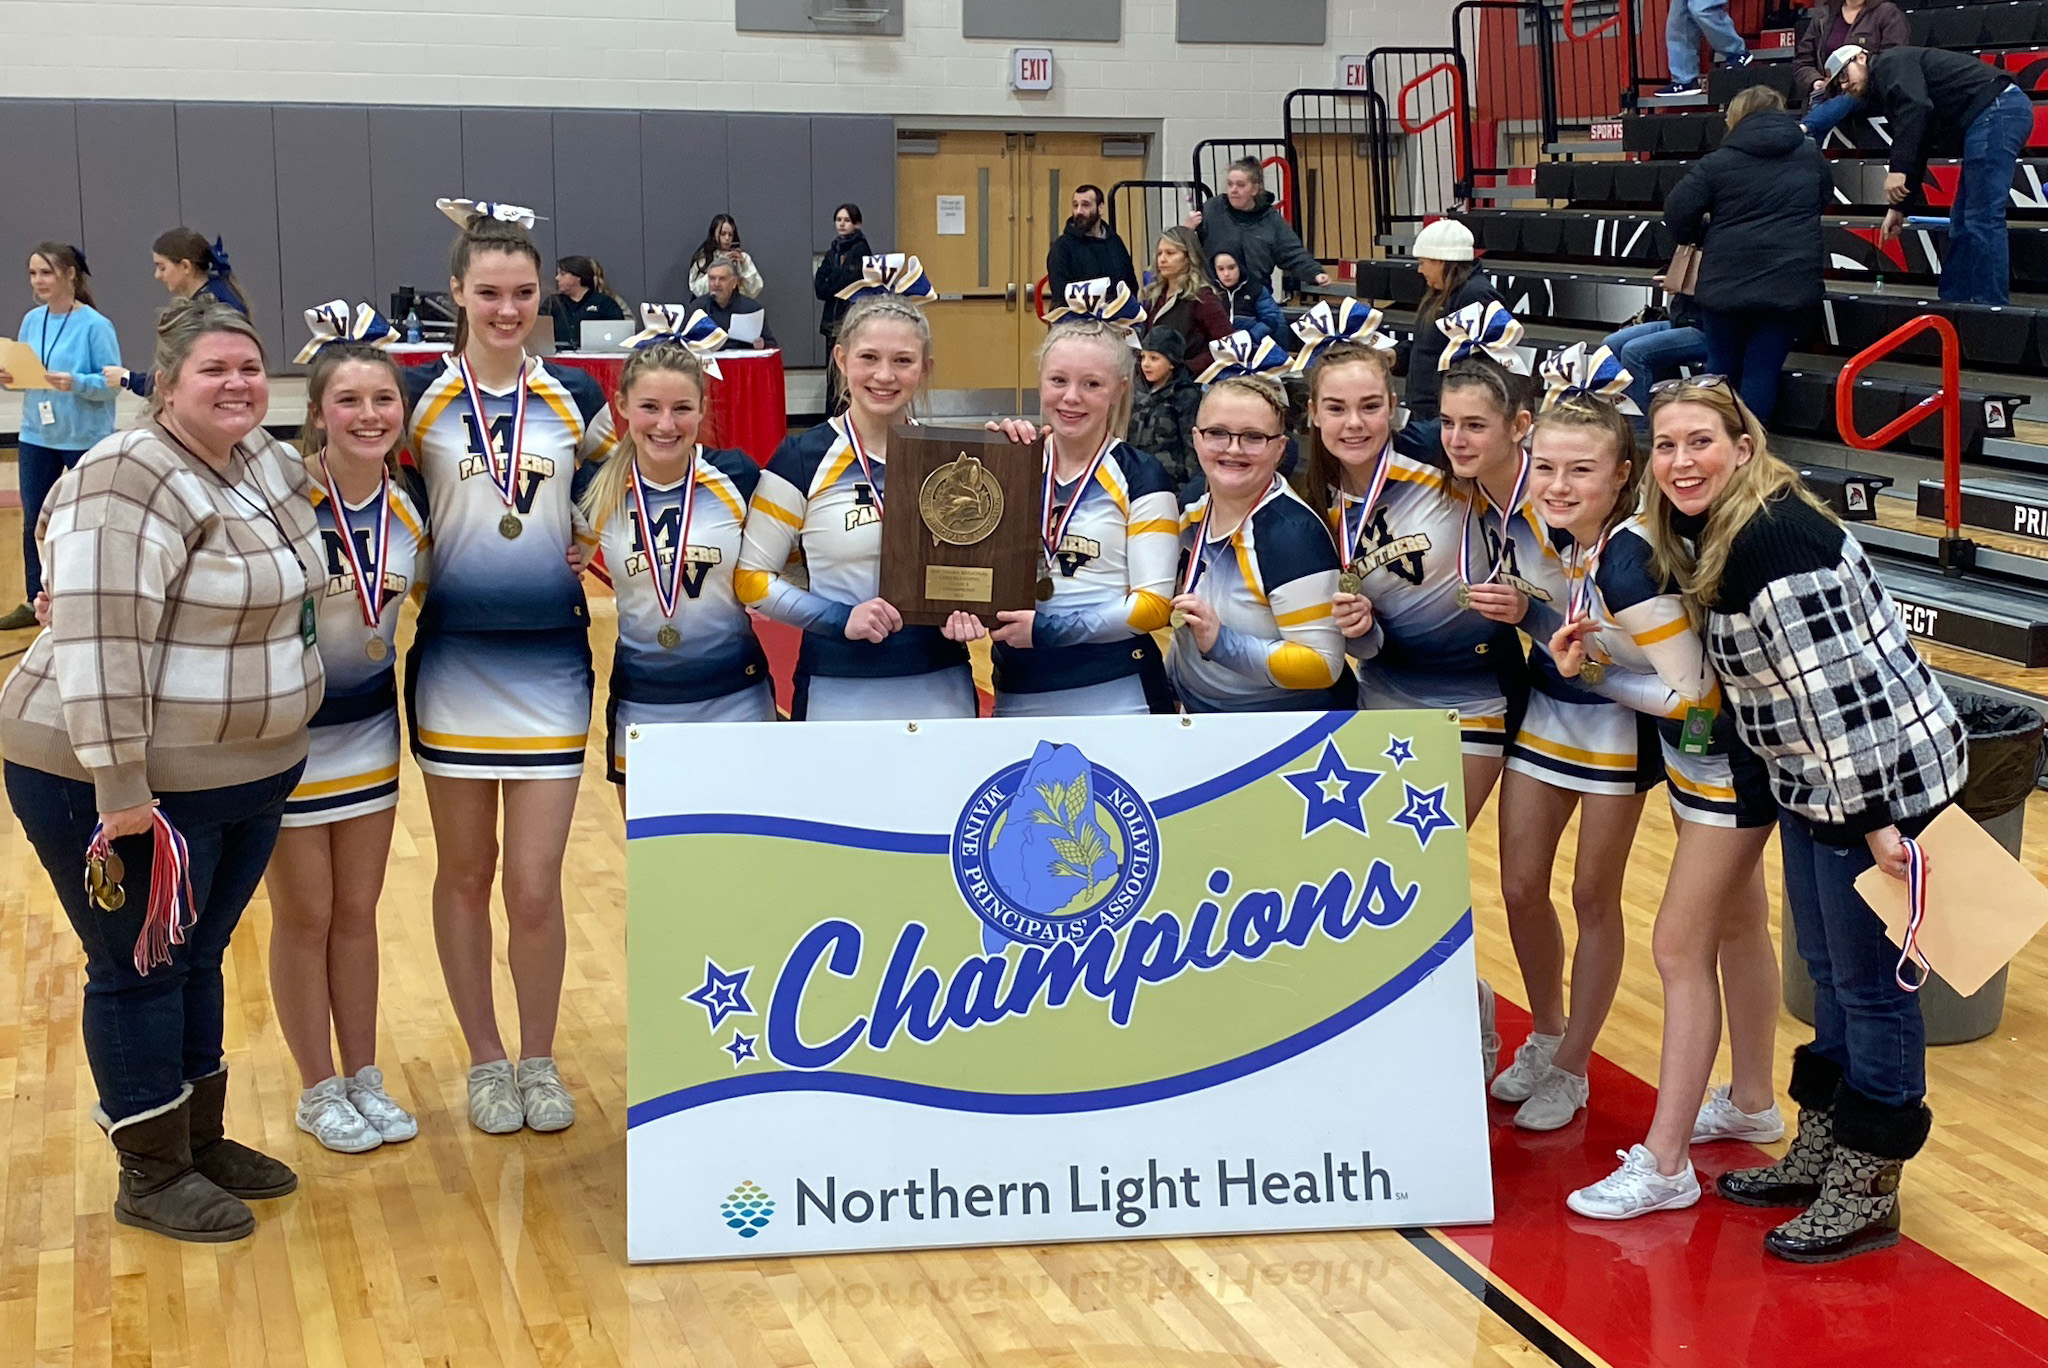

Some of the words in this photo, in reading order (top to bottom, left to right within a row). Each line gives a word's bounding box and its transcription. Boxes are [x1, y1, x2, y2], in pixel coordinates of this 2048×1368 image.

[1021, 58, 1048, 81] EXIT
[1346, 64, 1365, 86] EXI
[1591, 123, 1623, 140] SPORTS
[1069, 282, 1101, 313] MV
[459, 452, 555, 481] PATERS
[625, 544, 722, 577] PATERS
[1351, 532, 1433, 580] ANTHERS
[962, 784, 1007, 856] MAINE
[1099, 787, 1150, 926] ASSOCIATION
[964, 864, 1088, 941] PRINCIPALS'
[766, 859, 1419, 1069] Champions
[796, 1167, 1051, 1226] Northern
[1069, 1158, 1201, 1228] Light
[1216, 1150, 1392, 1207] Health
